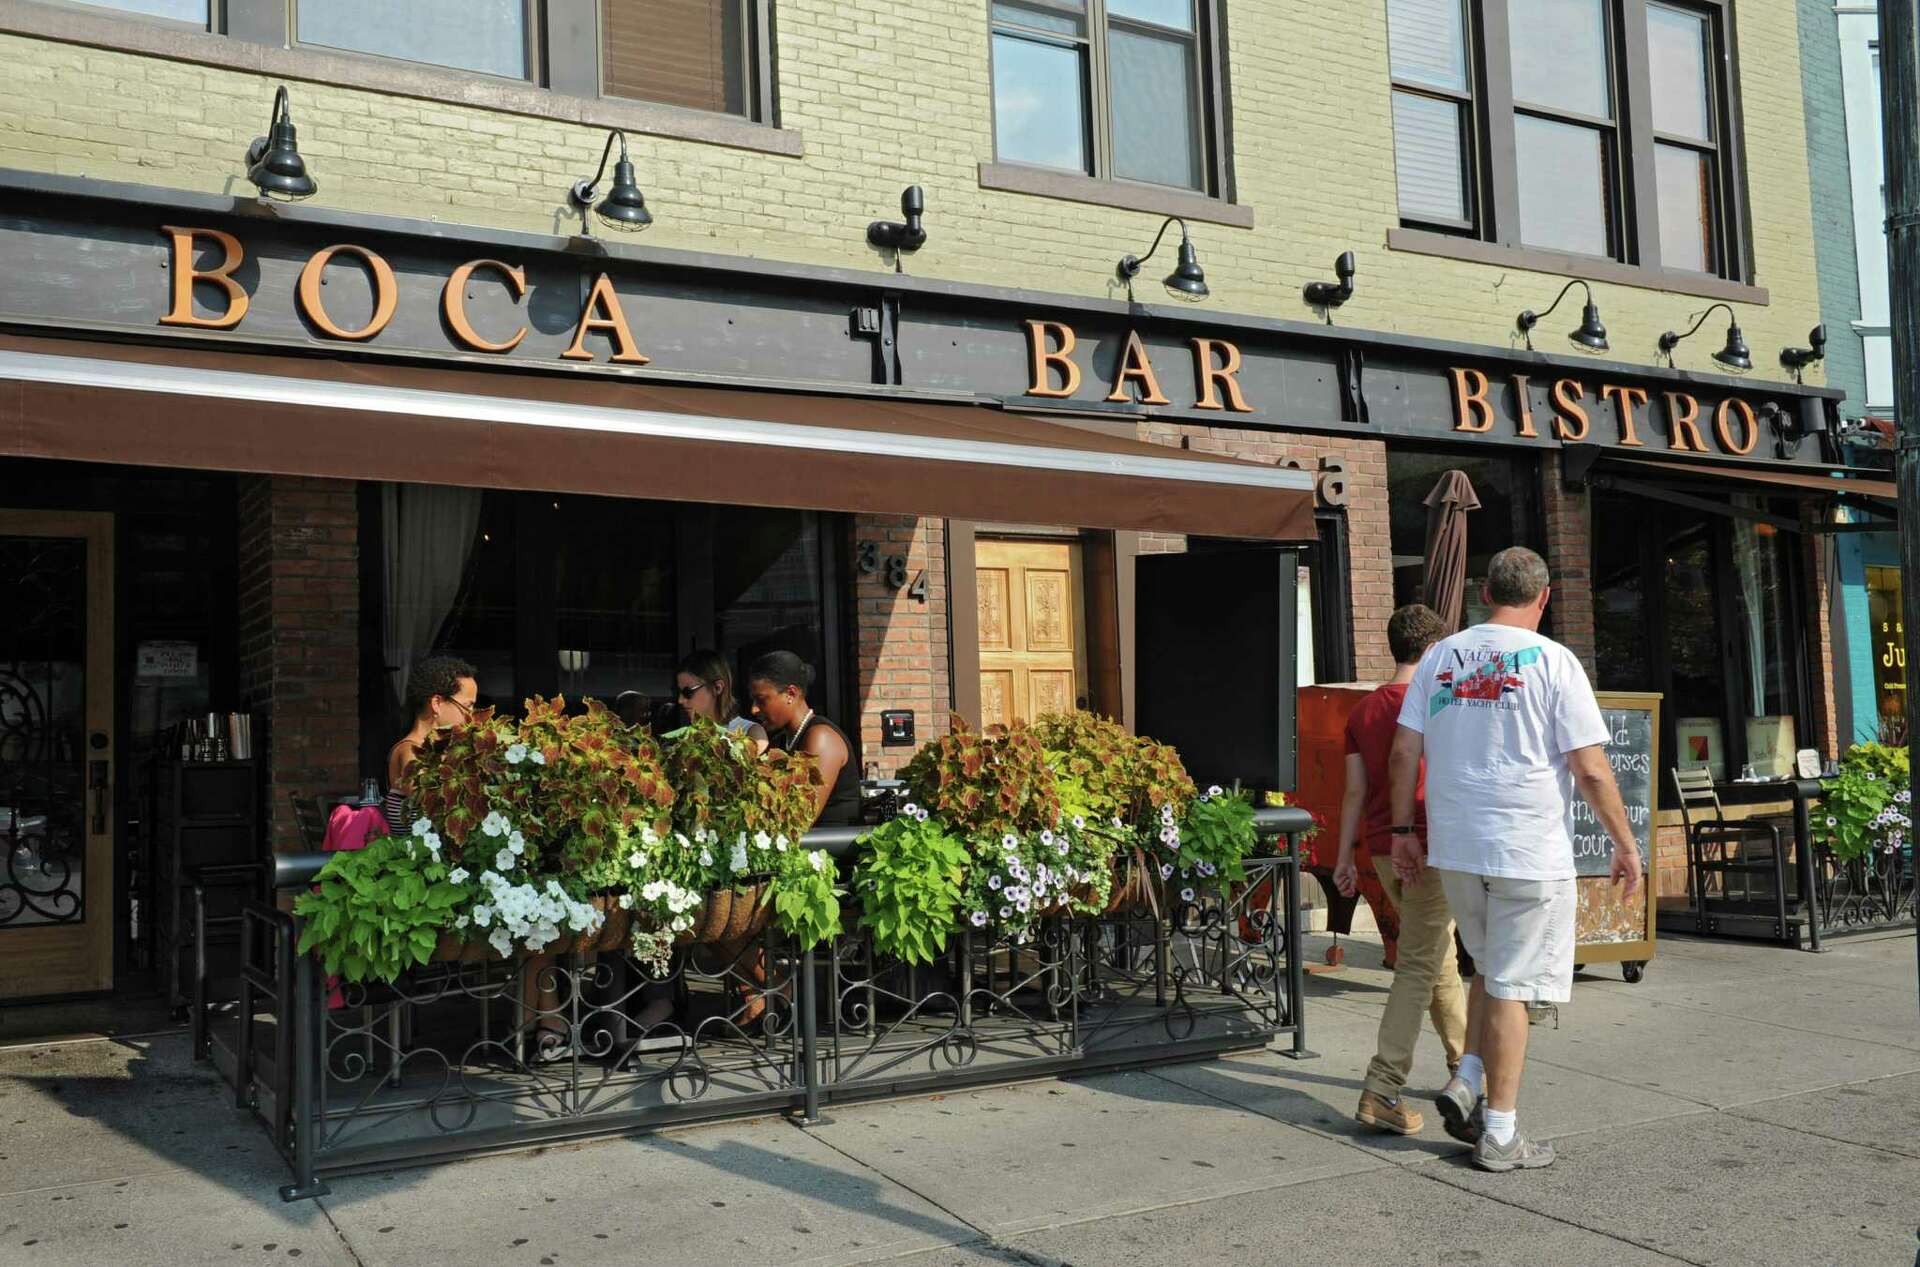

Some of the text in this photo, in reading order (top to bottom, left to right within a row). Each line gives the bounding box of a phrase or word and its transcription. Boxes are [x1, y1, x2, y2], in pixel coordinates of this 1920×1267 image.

[158, 224, 1760, 455] BOCA BAR BISTRO
[857, 540, 930, 604] 384
[1883, 642, 1905, 667] Ju
[1602, 715, 1630, 746] ld
[1607, 752, 1650, 773] orses
